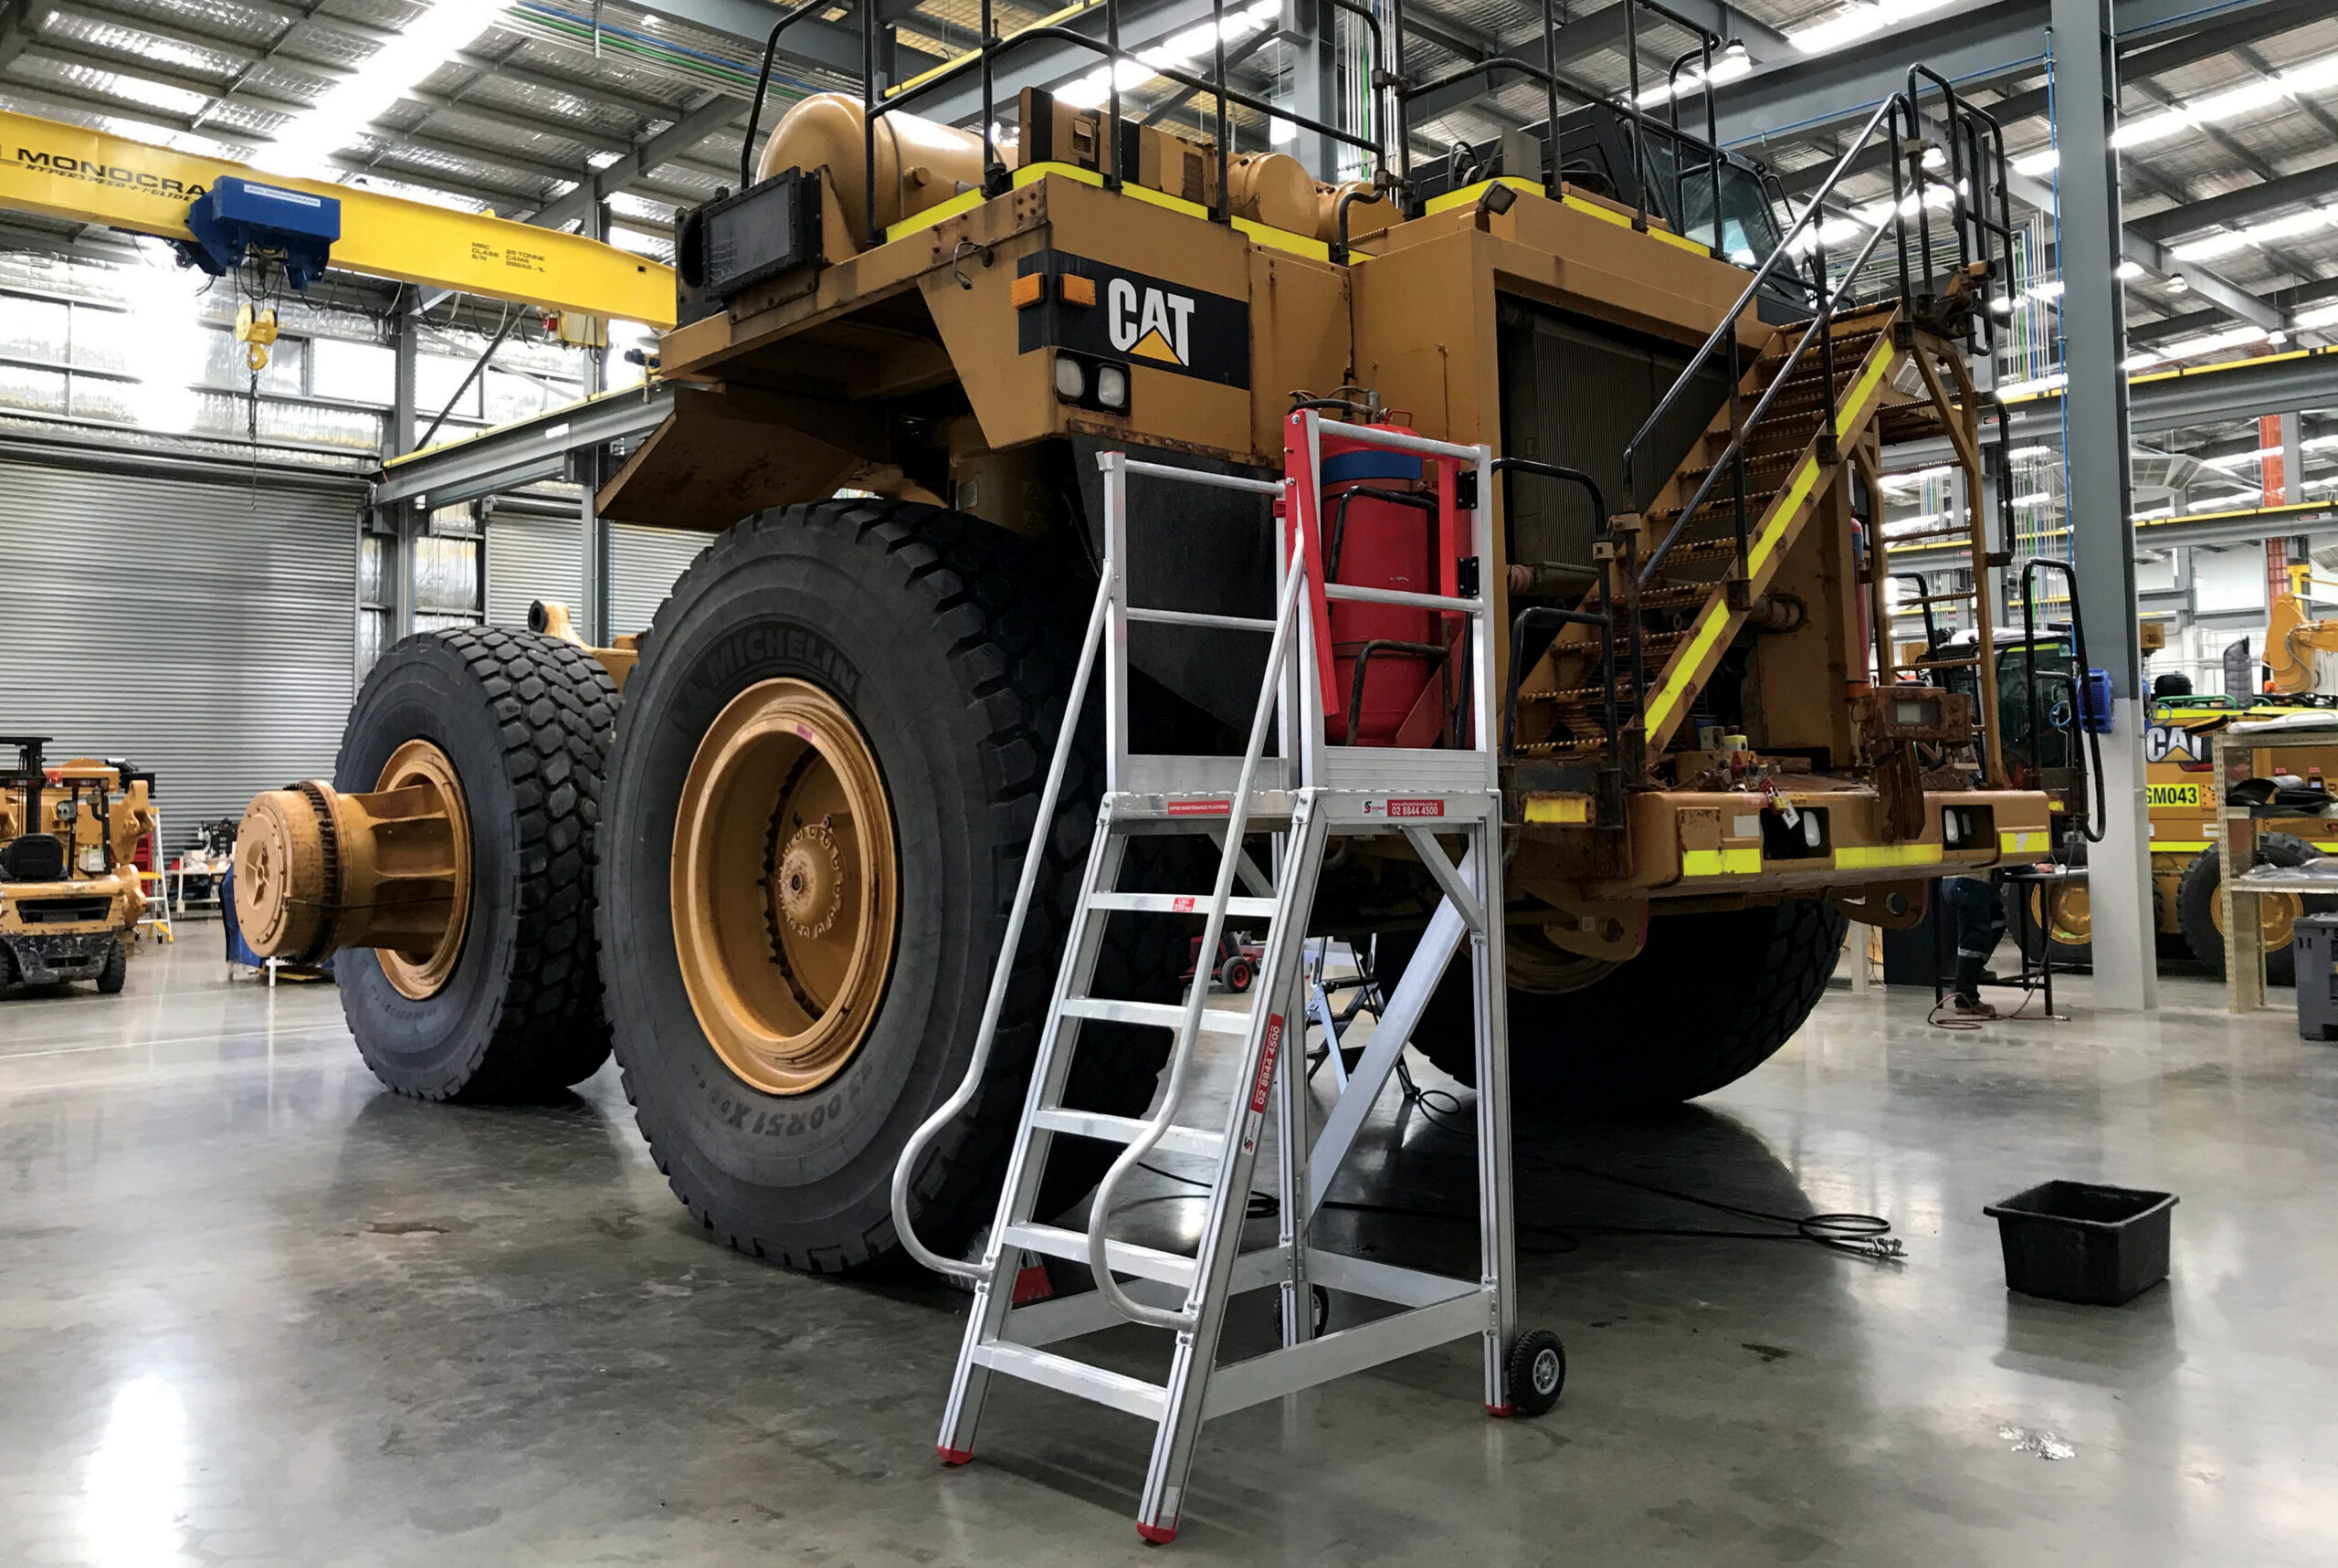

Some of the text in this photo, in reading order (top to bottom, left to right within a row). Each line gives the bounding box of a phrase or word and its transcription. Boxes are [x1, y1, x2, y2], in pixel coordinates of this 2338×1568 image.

[18, 148, 205, 195] MONOCRA
[1108, 278, 1195, 366] CAT
[706, 627, 861, 694] MICHELIN
[1392, 806, 1438, 816] 02 8844 4500
[1269, 1026, 1280, 1055] 4500
[1261, 1058, 1273, 1087] 8844
[1257, 1089, 1267, 1105] 02
